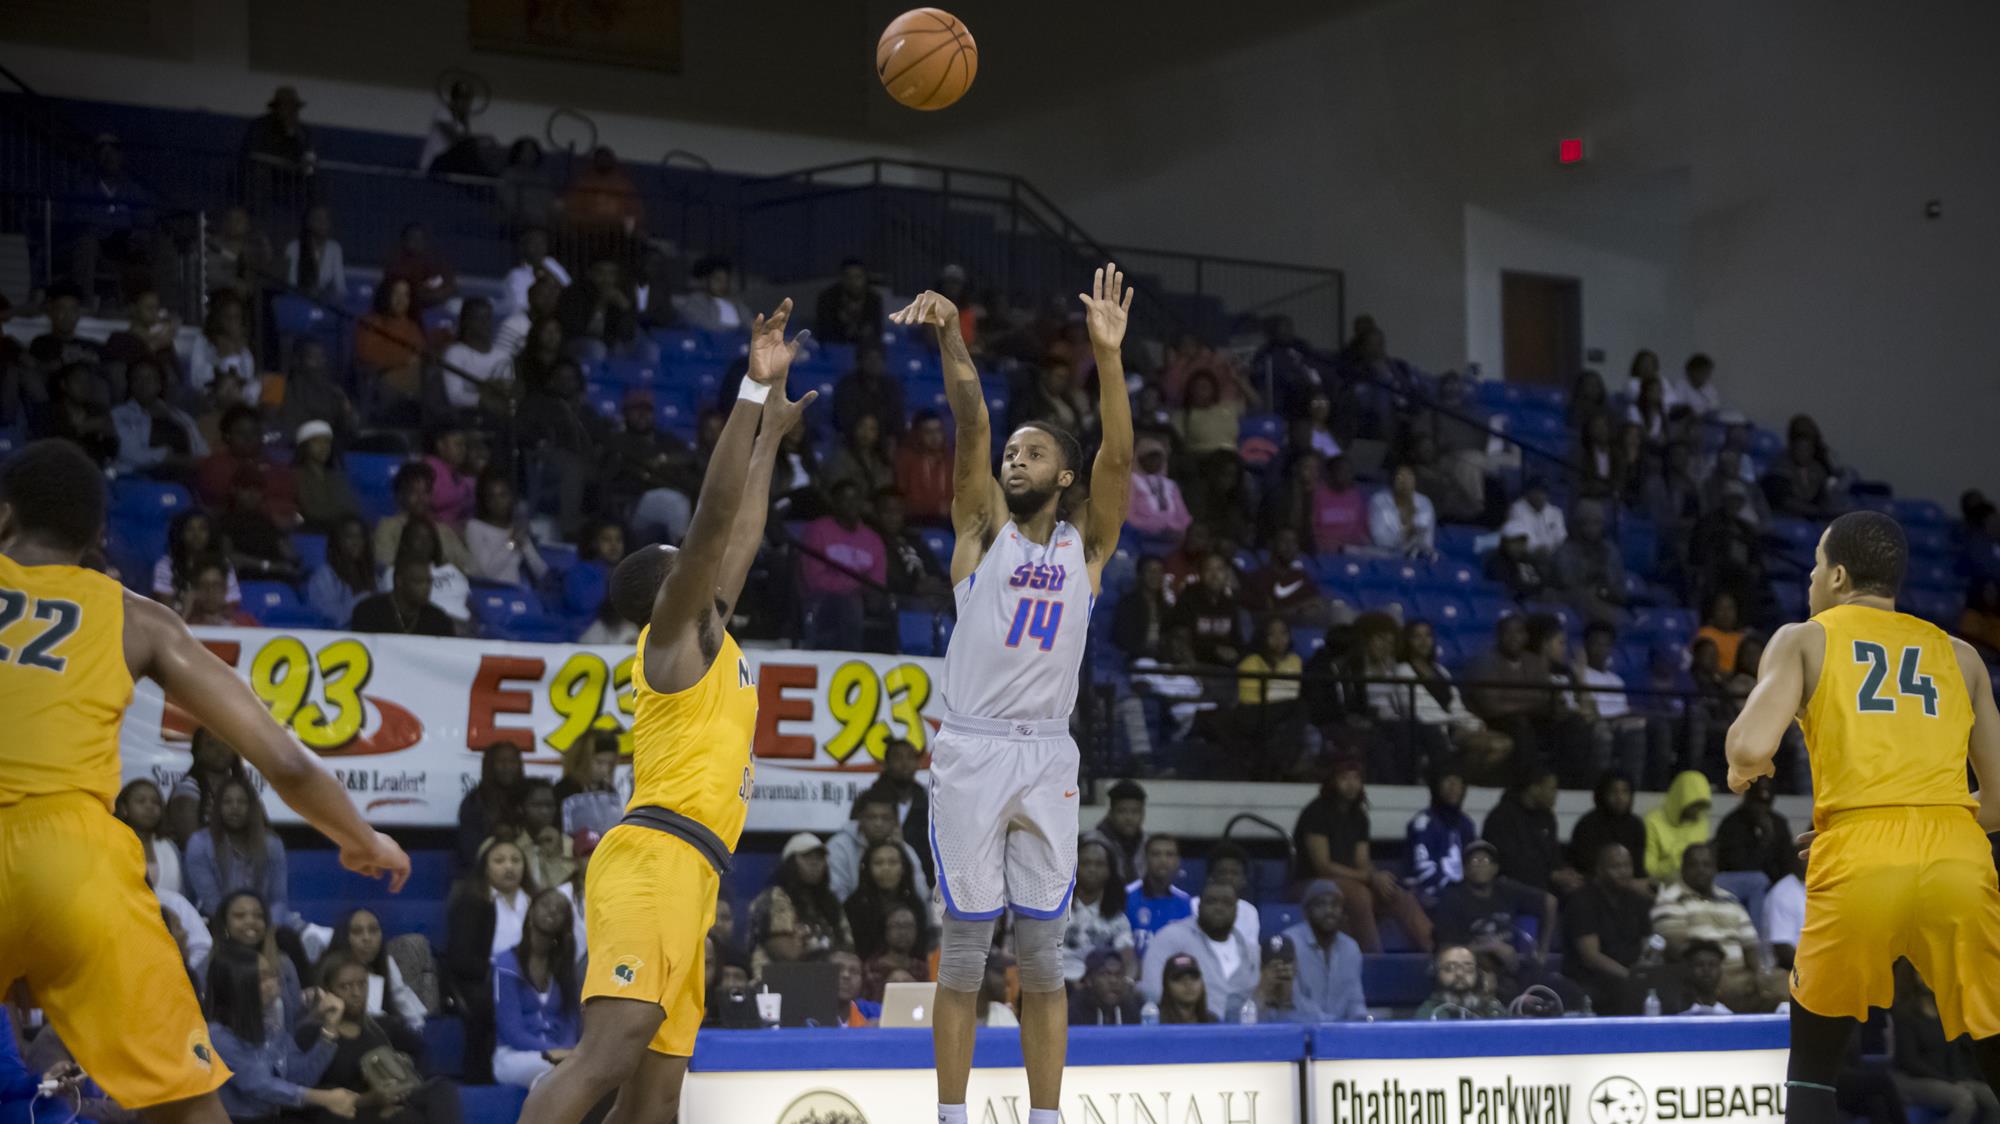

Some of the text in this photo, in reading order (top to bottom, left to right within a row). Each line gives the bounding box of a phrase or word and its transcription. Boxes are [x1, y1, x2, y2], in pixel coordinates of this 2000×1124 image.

[1009, 561, 1066, 592] SSU
[1005, 598, 1064, 652] 14
[1853, 640, 1939, 718] 24
[372, 769, 427, 792] Leader!
[751, 780, 819, 801] avannah's
[821, 781, 844, 806] Hip
[980, 1091, 1259, 1124] AVNNAH
[1332, 1074, 1571, 1124] Chatham Parkway
